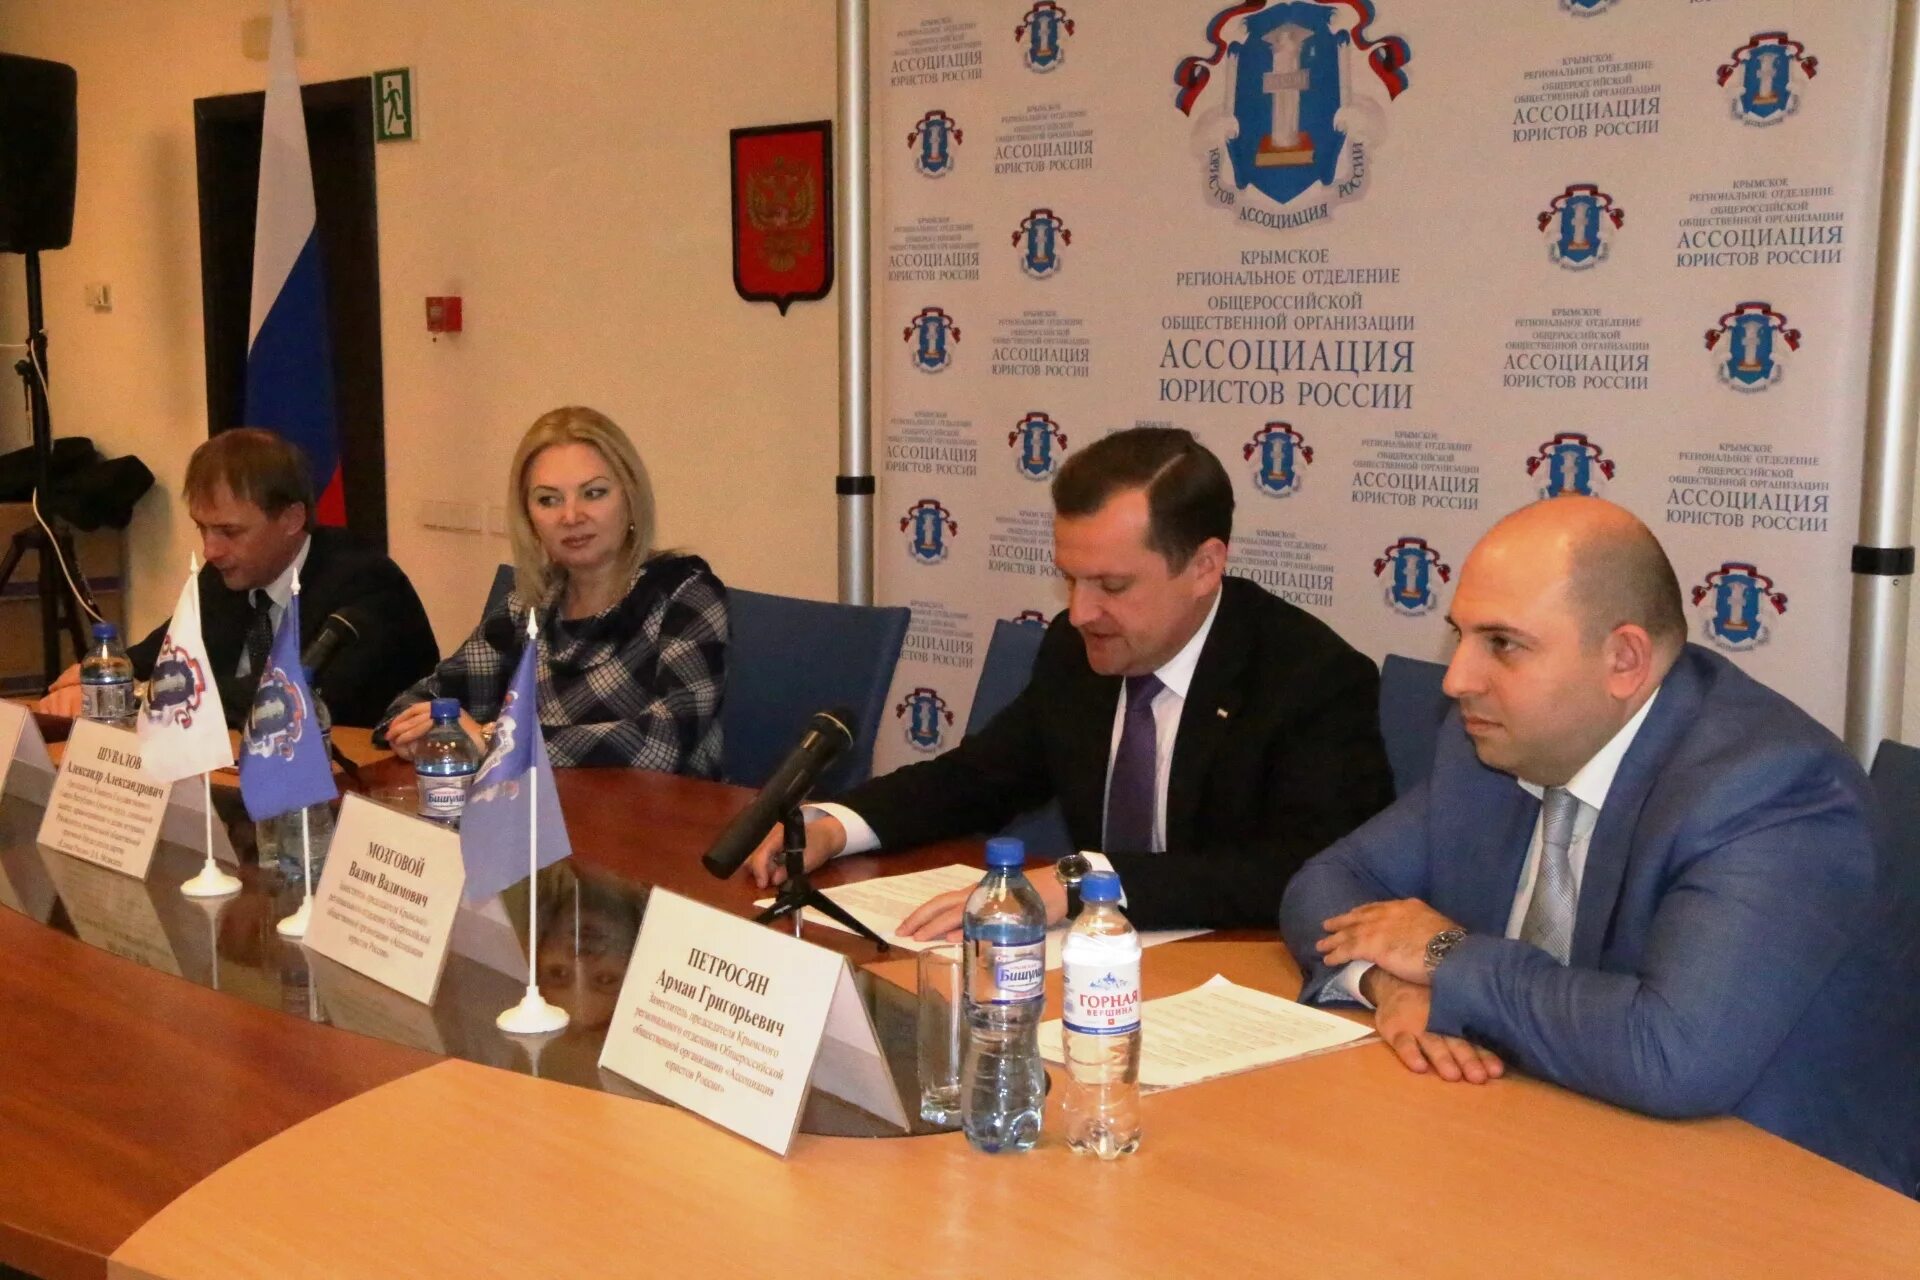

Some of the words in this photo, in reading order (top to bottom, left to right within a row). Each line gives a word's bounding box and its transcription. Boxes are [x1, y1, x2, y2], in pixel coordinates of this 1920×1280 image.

[891, 51, 982, 73] АССОЦИАЦИЯ
[891, 71, 938, 87] ЮРИСТОВ
[942, 68, 982, 82] РОССИИ
[1513, 97, 1660, 125] АССОЦИАЦИЯ
[1513, 125, 1587, 143] ЮРИСТОВ
[1594, 120, 1659, 137] РОССИИ
[995, 140, 1093, 160] АССОЦИАЦИЯ
[995, 159, 1045, 174] ЮРИСТОВ
[1049, 157, 1092, 170] РОССИИ
[1338, 142, 1363, 198] РОССИИ
[1209, 147, 1235, 205] ЮРИСТОВ
[1239, 203, 1328, 229] АССОЦИАЦИЯ
[1677, 226, 1843, 249] АССОЦИАЦИЯ
[889, 252, 979, 268] АССОЦИАЦИЯ
[1241, 249, 1329, 265] КРЫМСКОЕ
[1677, 251, 1759, 267] ЮРИСТОВ
[1767, 250, 1841, 265] РОССИИ
[888, 270, 935, 282] ЮРИСТОВ
[939, 269, 979, 281] РОССИИ
[1176, 270, 1296, 287] РЕГИОНАЛЬНОЕ
[1303, 268, 1400, 286] ОТДЕЛЕНИЕ
[1208, 291, 1362, 311] ОБЩЕРОССИЙСКОЙ
[1162, 313, 1287, 331] ОБЩЕСТВЕННОЙ
[1294, 315, 1415, 332] ОРГАНИЗАЦИИ
[992, 348, 1089, 363] АССОЦИАЦИЯ
[1160, 339, 1415, 378] АССОЦИАЦИЯ
[1504, 354, 1649, 372] АССОЦИАЦИЯ
[992, 365, 1040, 376] ЮРИСТОВ
[1046, 365, 1089, 377] РОССИИ
[1503, 374, 1576, 388] ЮРИСТОВ
[1583, 376, 1648, 389] РОССИИ
[1160, 379, 1284, 405] ЮРИСТОВ
[1297, 382, 1414, 409] РОССИИ
[887, 446, 977, 463] АССОЦИАЦИЯ
[886, 461, 932, 473] ЮРИСТОВ
[937, 463, 977, 476] РОССИИ
[1352, 472, 1479, 494] АССОЦИАЦИЯ
[1352, 490, 1416, 506] ЮРИСТОВ
[1422, 495, 1479, 511] РОССИИ
[1667, 488, 1829, 514] АССОЦИАЦИЯ
[1666, 509, 1744, 527] ЮРИСТОВ
[1752, 515, 1828, 532] РОССИИ
[989, 544, 1053, 562] АССОЦИА
[988, 560, 1035, 574] ЮРИСТОВ
[1282, 589, 1332, 606] РОССИИ
[933, 652, 974, 668] РОССИИ
[97, 747, 142, 770] ШУВАЛОВ
[68, 761, 103, 784] Александр
[104, 772, 163, 799] Александрович
[367, 842, 425, 878] МОЗГОВОЙ
[688, 947, 770, 996] ПЕТРОСЯН
[656, 969, 697, 999] Арман
[699, 985, 785, 1037] Григорьевич
[1080, 989, 1138, 1008] ГОРНАЯ
[1087, 1007, 1132, 1016] ВЕРШИНА
[737, 1030, 779, 1058] Крымского
